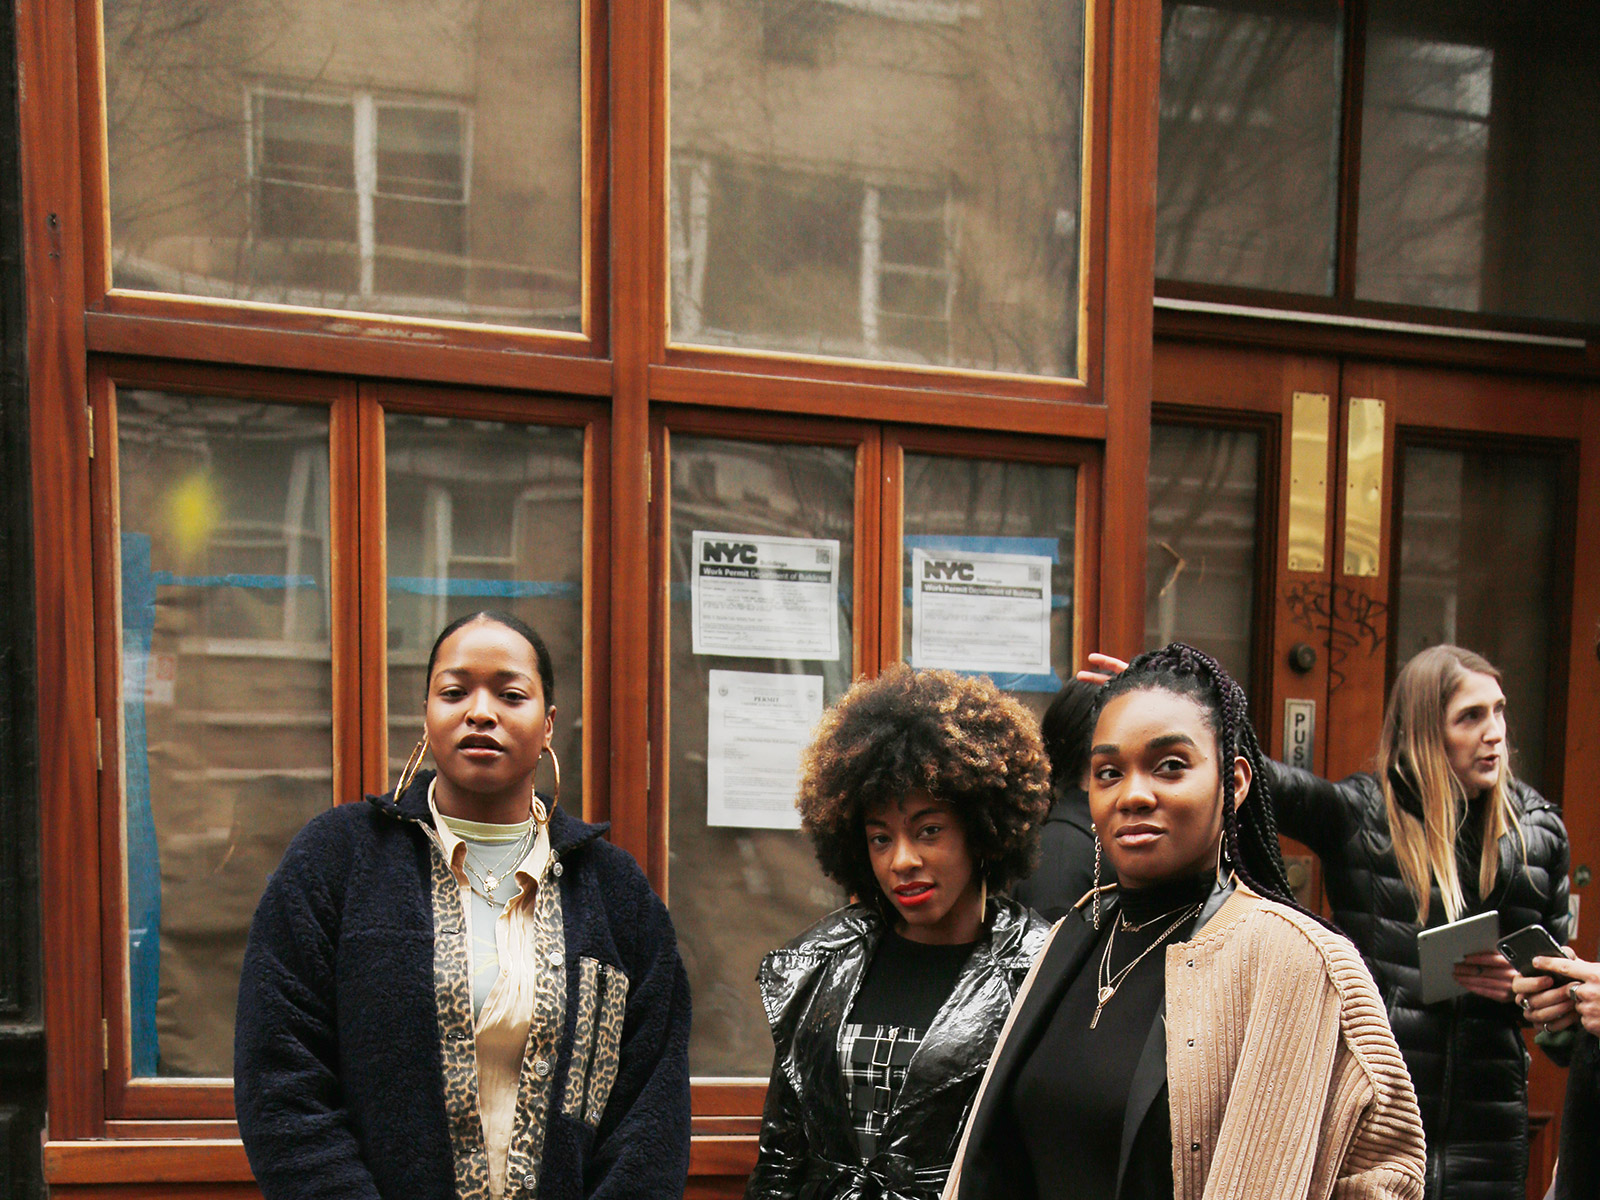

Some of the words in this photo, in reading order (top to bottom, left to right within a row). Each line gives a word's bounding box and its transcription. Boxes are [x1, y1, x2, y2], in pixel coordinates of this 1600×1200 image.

[703, 541, 758, 564] NYC
[703, 566, 723, 576] Work
[724, 568, 750, 577] Permit
[790, 572, 797, 580] of
[924, 560, 974, 581] NYC
[924, 583, 943, 592] Work
[944, 584, 967, 593] Permit
